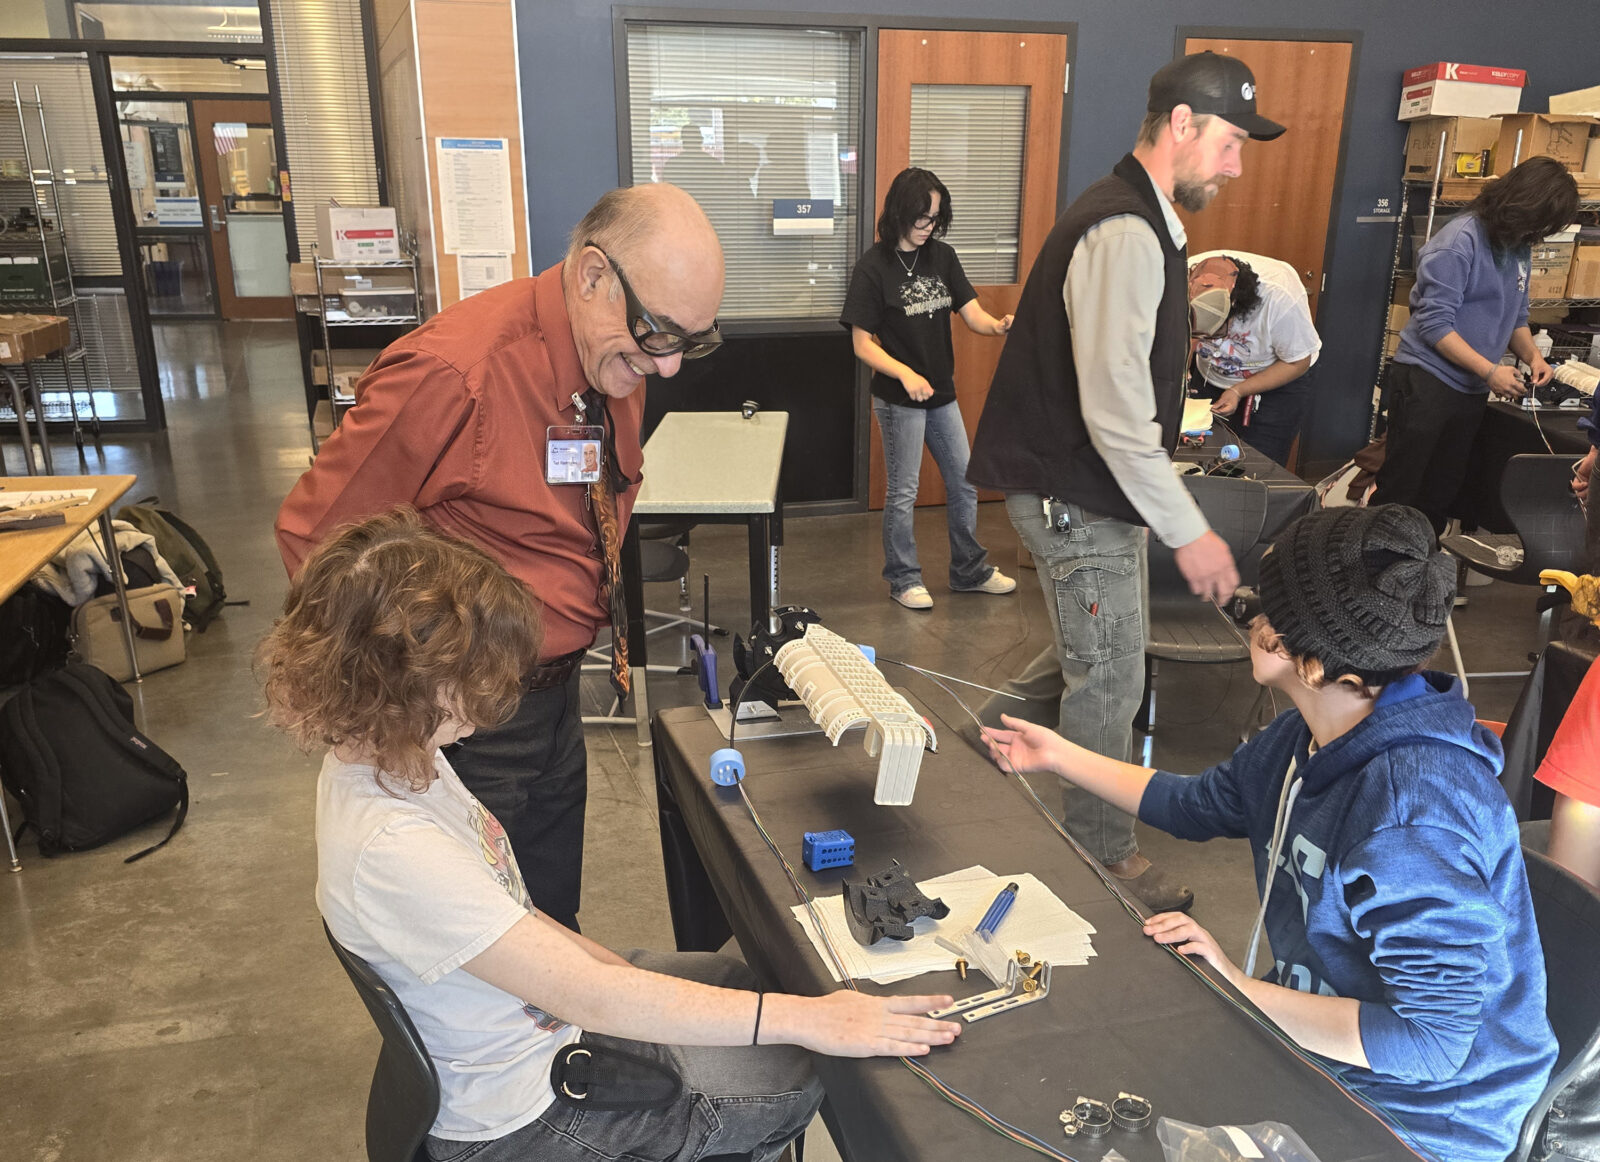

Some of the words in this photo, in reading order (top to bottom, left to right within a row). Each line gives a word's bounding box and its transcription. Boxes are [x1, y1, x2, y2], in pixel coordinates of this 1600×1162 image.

[1444, 63, 1460, 80] K
[1377, 198, 1389, 207] 356
[796, 204, 812, 214] 357
